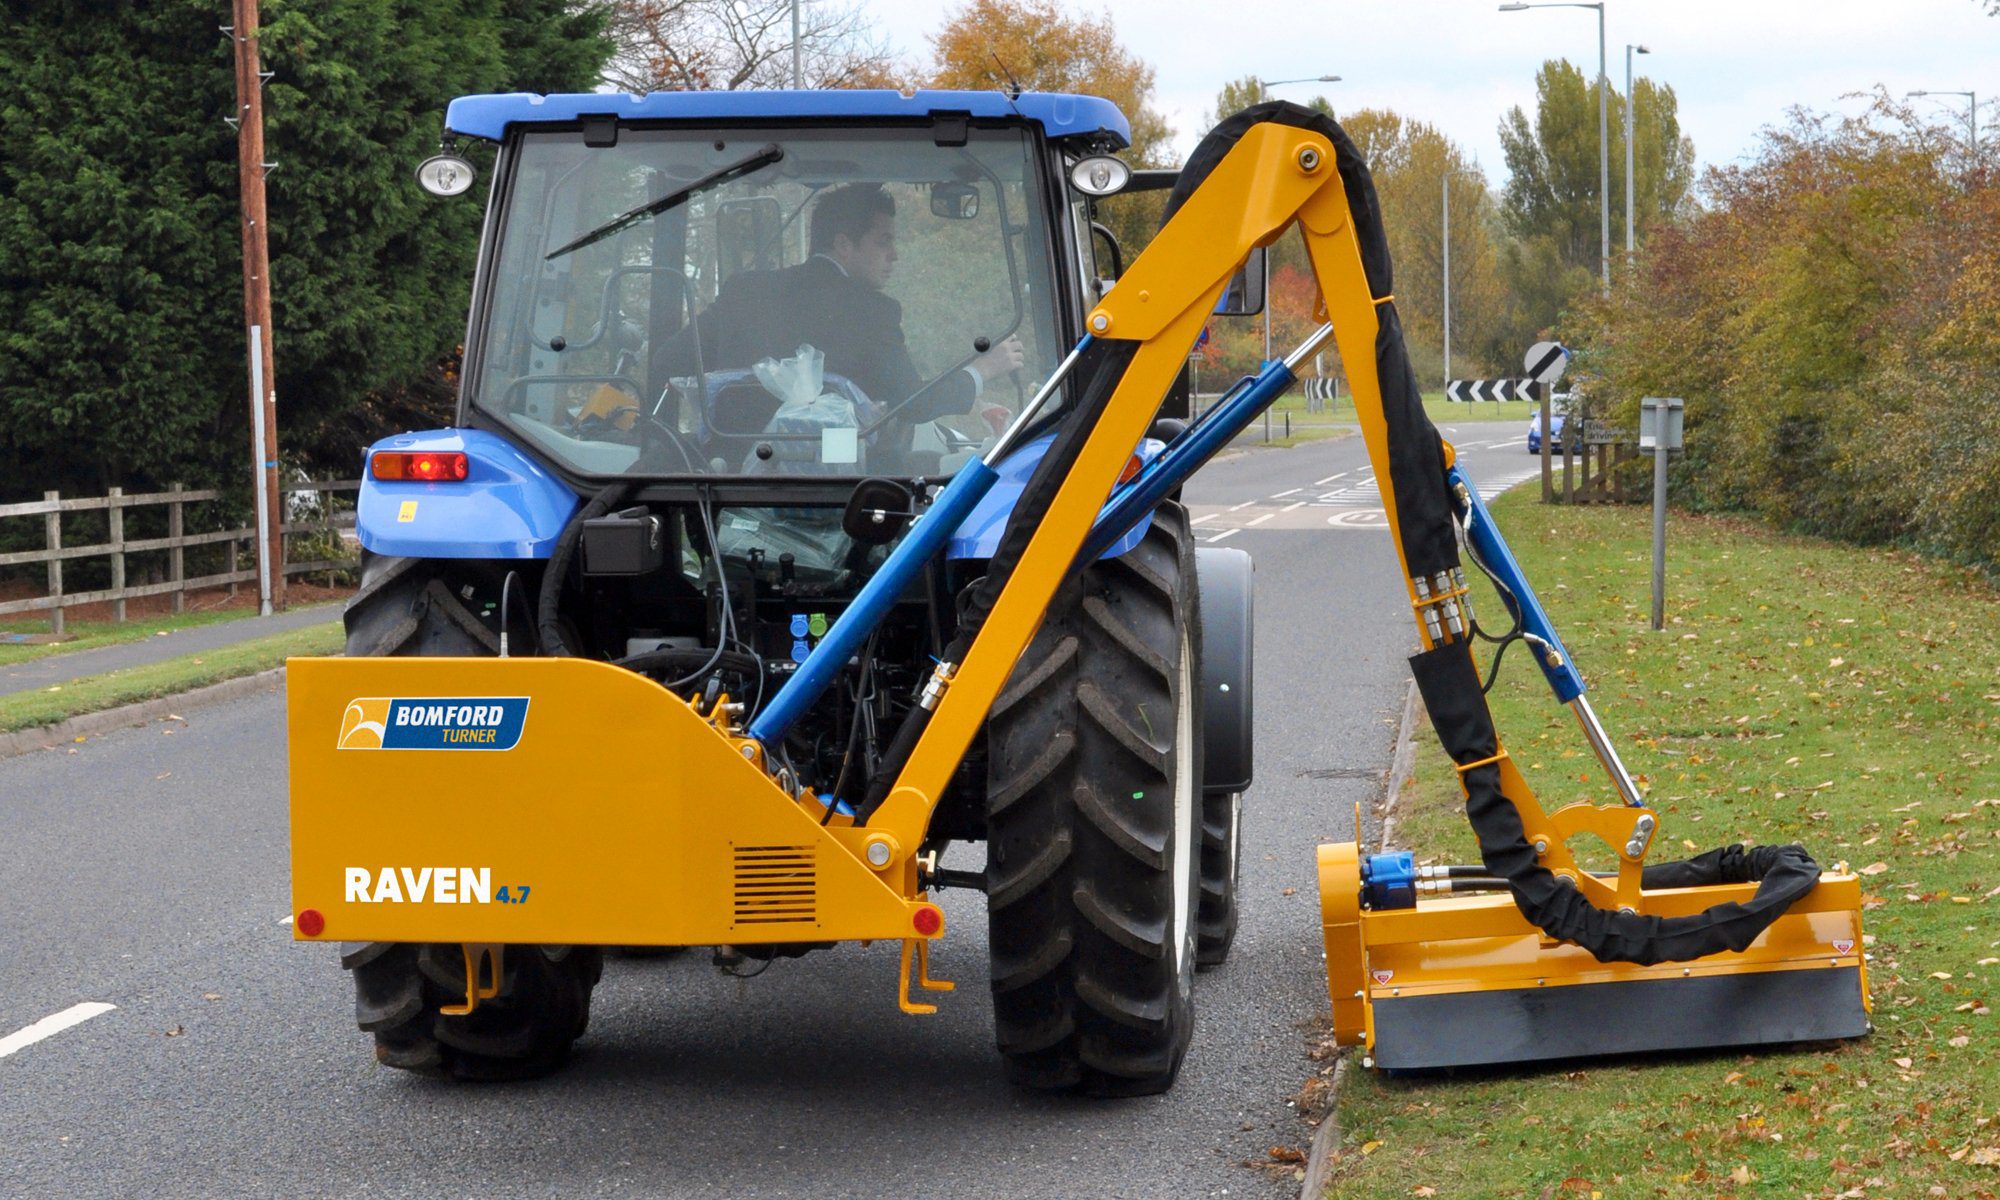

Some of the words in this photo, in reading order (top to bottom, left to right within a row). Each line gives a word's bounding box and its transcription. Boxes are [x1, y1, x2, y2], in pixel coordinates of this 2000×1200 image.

[396, 706, 504, 726] BOMFORD
[442, 728, 497, 743] TURNER
[345, 866, 491, 904] RAVEN
[495, 885, 531, 904] 4.7
